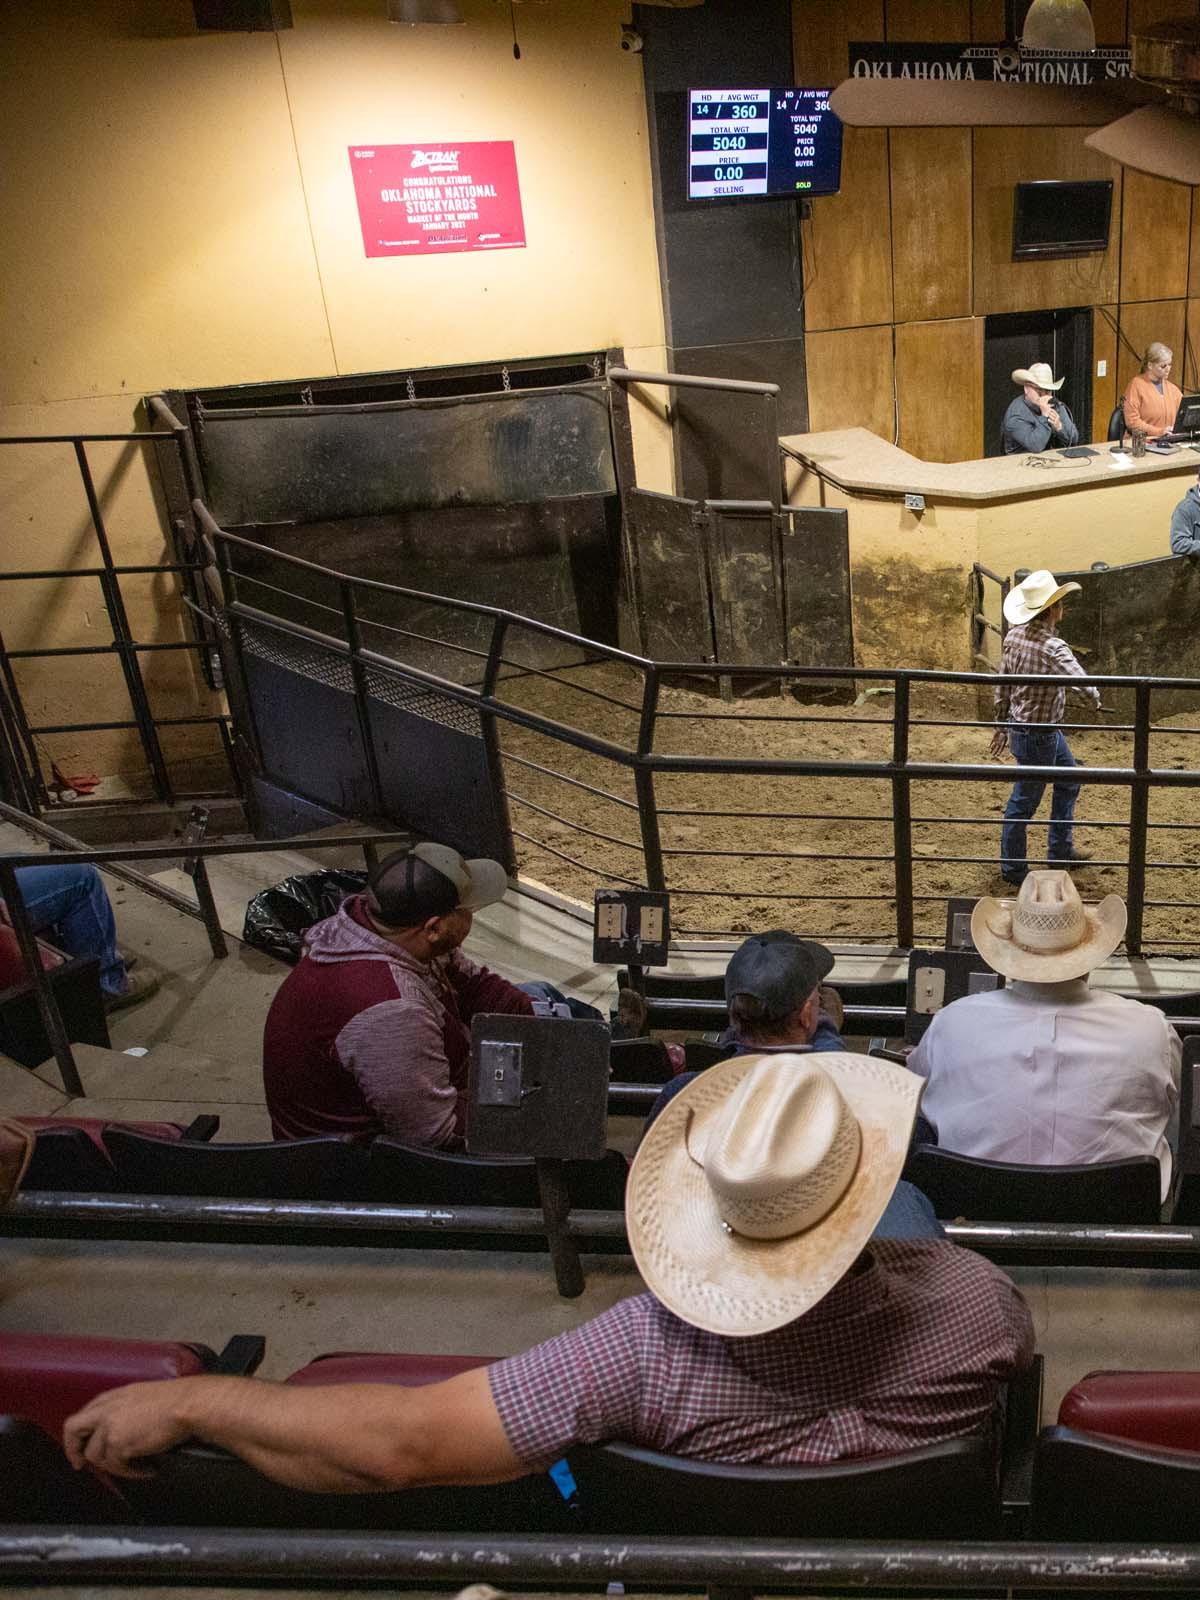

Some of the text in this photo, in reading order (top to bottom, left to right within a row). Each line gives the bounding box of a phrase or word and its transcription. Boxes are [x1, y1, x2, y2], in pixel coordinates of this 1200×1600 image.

[743, 93, 759, 101] WGT
[776, 100, 787, 110] 14
[697, 104, 757, 119] 14 / 360
[790, 115, 808, 123] TOTAL
[793, 124, 818, 135] 5040
[712, 136, 746, 150] 5040
[794, 146, 815, 157] 0.00
[714, 167, 743, 181] 0.00
[403, 175, 473, 187] CONGRATULATIONS
[381, 184, 498, 203] OKLAHOMA NATIONAL
[713, 186, 744, 194] SELLING
[406, 198, 477, 214] STOCKYARDS
